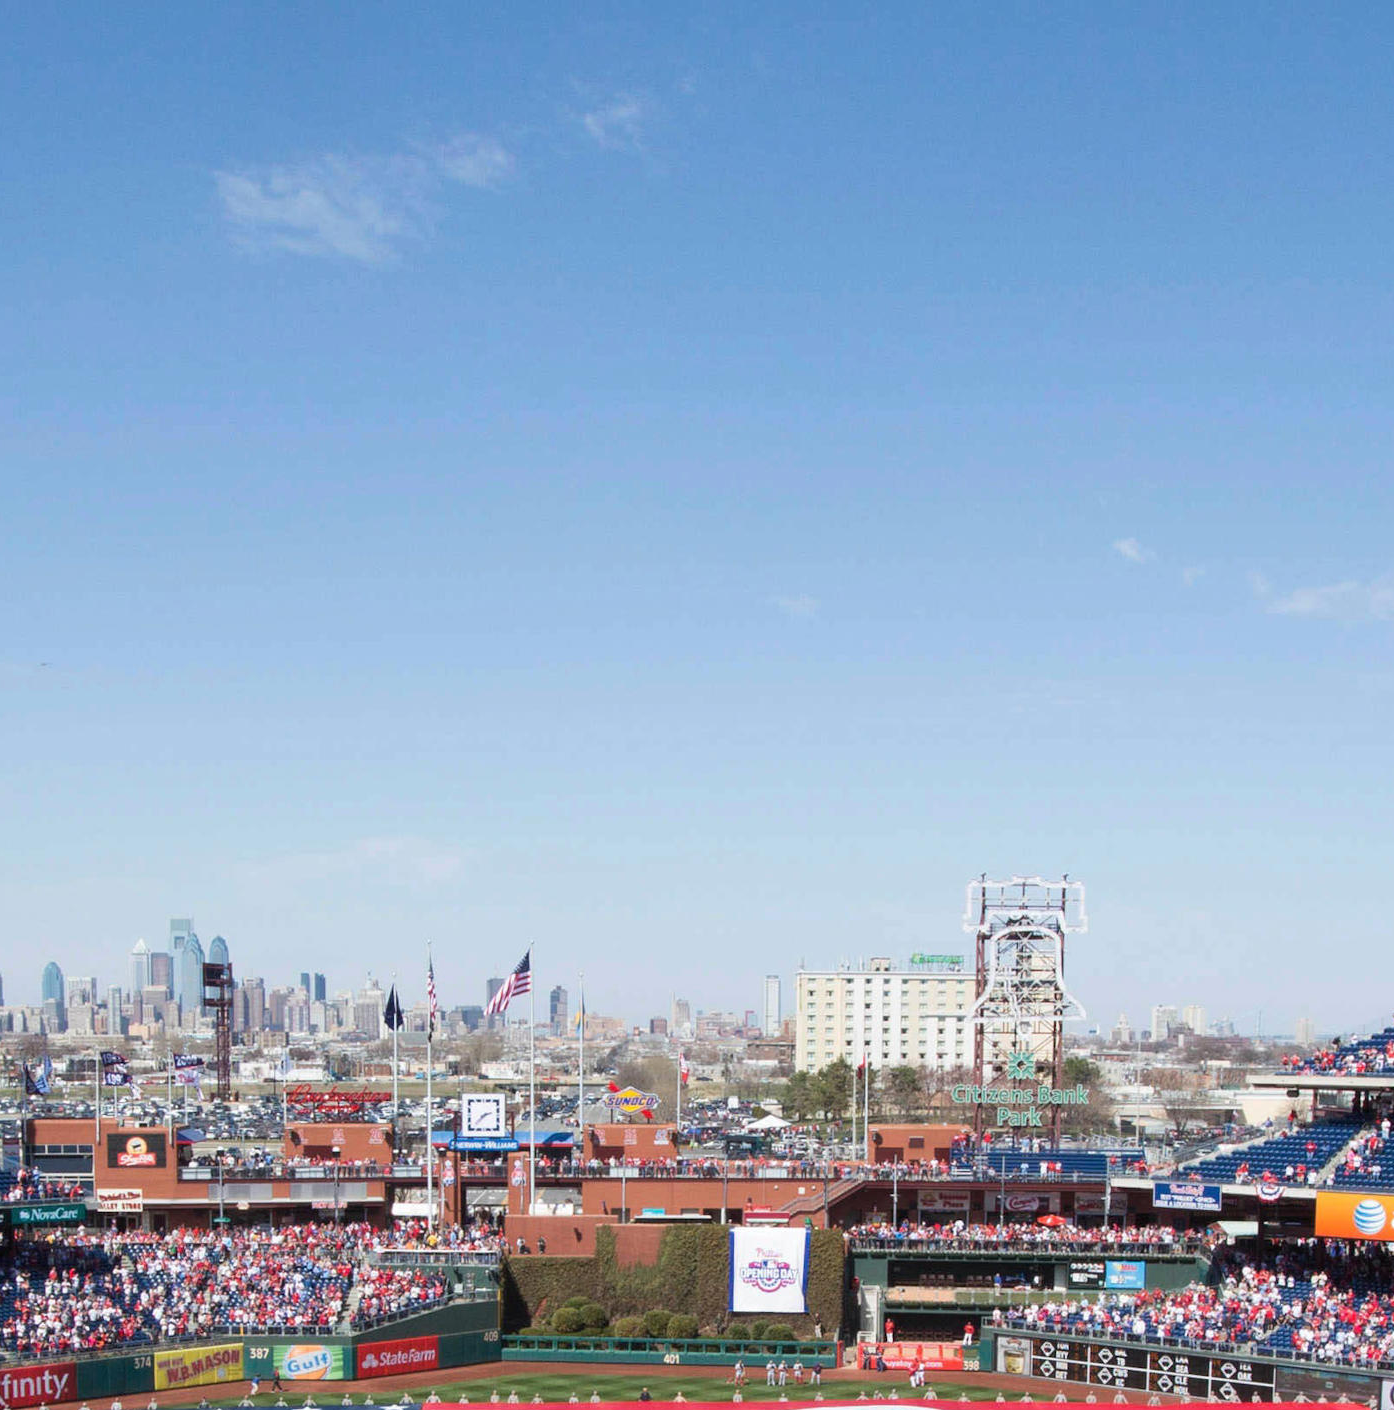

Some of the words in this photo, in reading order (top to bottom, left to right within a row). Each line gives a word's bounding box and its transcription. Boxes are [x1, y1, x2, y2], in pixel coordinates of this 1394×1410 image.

[952, 1083, 1033, 1104] Citizens
[1038, 1084, 1089, 1104] Bank
[606, 1096, 654, 1107] SUNOCO
[997, 1107, 1043, 1126] Park
[31, 1206, 78, 1221] NovaCare
[740, 1268, 779, 1280] OPENING
[780, 1269, 799, 1280] DAY
[483, 1331, 498, 1342] 409
[250, 1348, 269, 1359] 387
[1056, 1351, 1068, 1359] NYY
[133, 1357, 151, 1370] 374
[287, 1353, 328, 1372] Gulf
[663, 1354, 681, 1365] 401
[1117, 1357, 1125, 1366] TB
[963, 1360, 980, 1371] 398
[1175, 1365, 1189, 1374] SEA
[1113, 1369, 1128, 1378] CWS
[1238, 1372, 1252, 1381] OAK
[1115, 1379, 1124, 1388] KC
[1175, 1376, 1188, 1385] CLE
